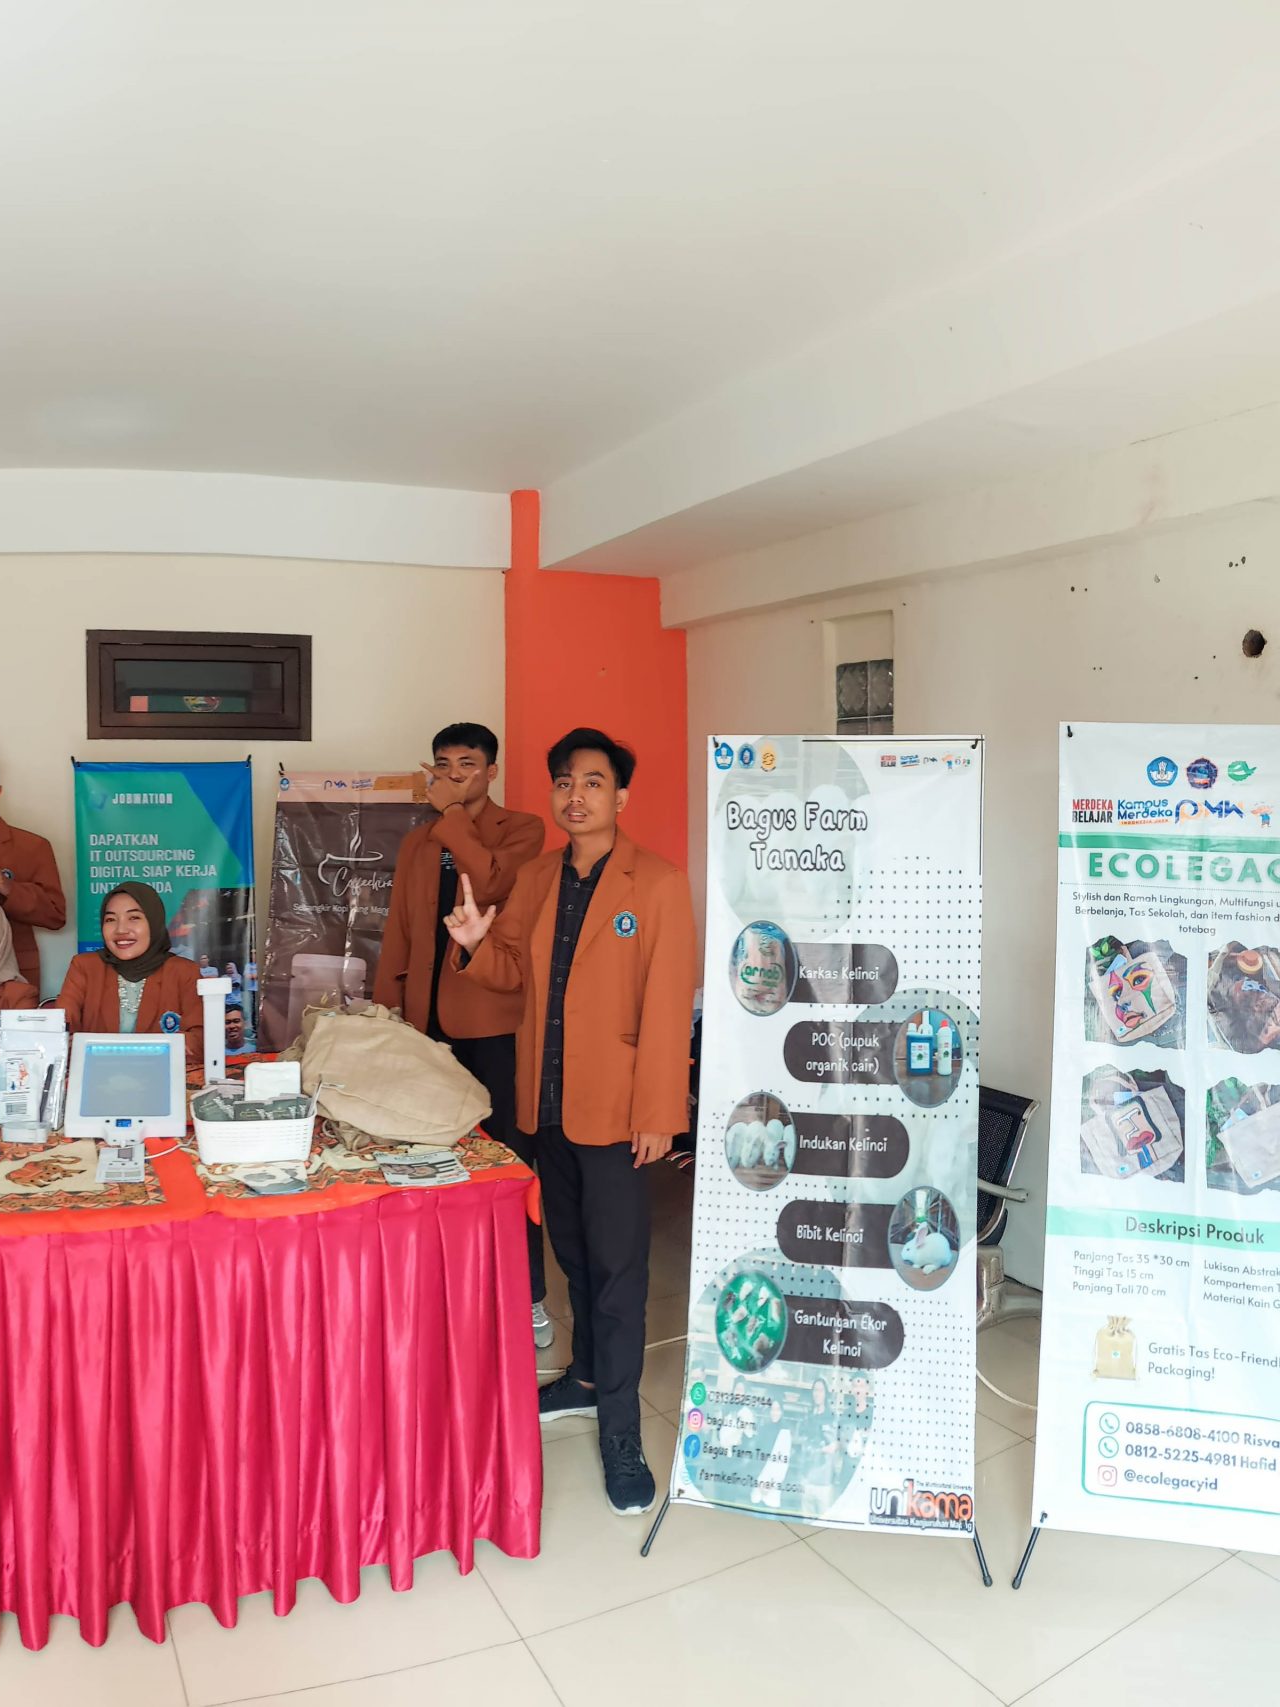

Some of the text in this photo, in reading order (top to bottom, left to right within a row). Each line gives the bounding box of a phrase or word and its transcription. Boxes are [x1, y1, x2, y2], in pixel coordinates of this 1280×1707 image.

[1072, 799, 1114, 811] MERDEKA
[1118, 798, 1168, 812] Kampus
[726, 801, 868, 840] Bagus Farm
[1072, 808, 1173, 824] BELAJAR Merdeka
[89, 834, 158, 846] DAPATKAN
[90, 849, 196, 862] IT OUTSOURCING
[749, 842, 846, 872] Tanaka
[90, 864, 218, 878] DIGITAL SIAP KERJA
[1072, 892, 1102, 904] Stylish
[1104, 892, 1120, 902] dan
[1124, 893, 1157, 903] Ramah
[1160, 894, 1217, 908] Lingkungan,
[1220, 895, 1274, 909] Multifungsi
[1075, 906, 1127, 918] Berbelanja,
[1129, 907, 1146, 917] Tas
[1148, 908, 1188, 920] Sekolah,
[1190, 910, 1208, 920] dan
[1211, 910, 1233, 920] item
[1235, 911, 1270, 922] fashion
[1178, 924, 1216, 936] totebag
[799, 965, 880, 982] Karkas Kelinci
[812, 1032, 880, 1050] POC (pupuk
[806, 1057, 880, 1076] organik cair)
[799, 1135, 888, 1152] Indukan Kelinci
[796, 1224, 864, 1244] Bibit Kelinci
[1126, 1216, 1265, 1244] Deskripsi Produk
[1074, 1250, 1114, 1264] Panjang
[1116, 1252, 1134, 1262] Tas
[1136, 1254, 1150, 1264] 35
[1175, 1259, 1190, 1268] cm
[1204, 1259, 1240, 1274] Lukisan
[1073, 1265, 1104, 1279] Tinggi
[1106, 1268, 1124, 1278] Tas
[1140, 1272, 1154, 1280] cm
[1072, 1281, 1166, 1296] Panjang Tali 70 cm
[1204, 1275, 1274, 1293] Kompartemen
[1203, 1291, 1245, 1305] Material
[1248, 1296, 1270, 1309] Kain
[794, 1309, 887, 1333] Gantungan Ekor
[823, 1339, 863, 1358] Kelinci
[1148, 1342, 1186, 1357] Gratis
[1189, 1345, 1210, 1359] Tas
[1148, 1362, 1215, 1381] Packaging!
[703, 1441, 788, 1464] Bagus Farm Tanaka
[1125, 1444, 1276, 1471] 0812-5225-4981 Hafid
[1124, 1469, 1218, 1492] @ecolegacyid
[870, 1478, 973, 1521] unikama
